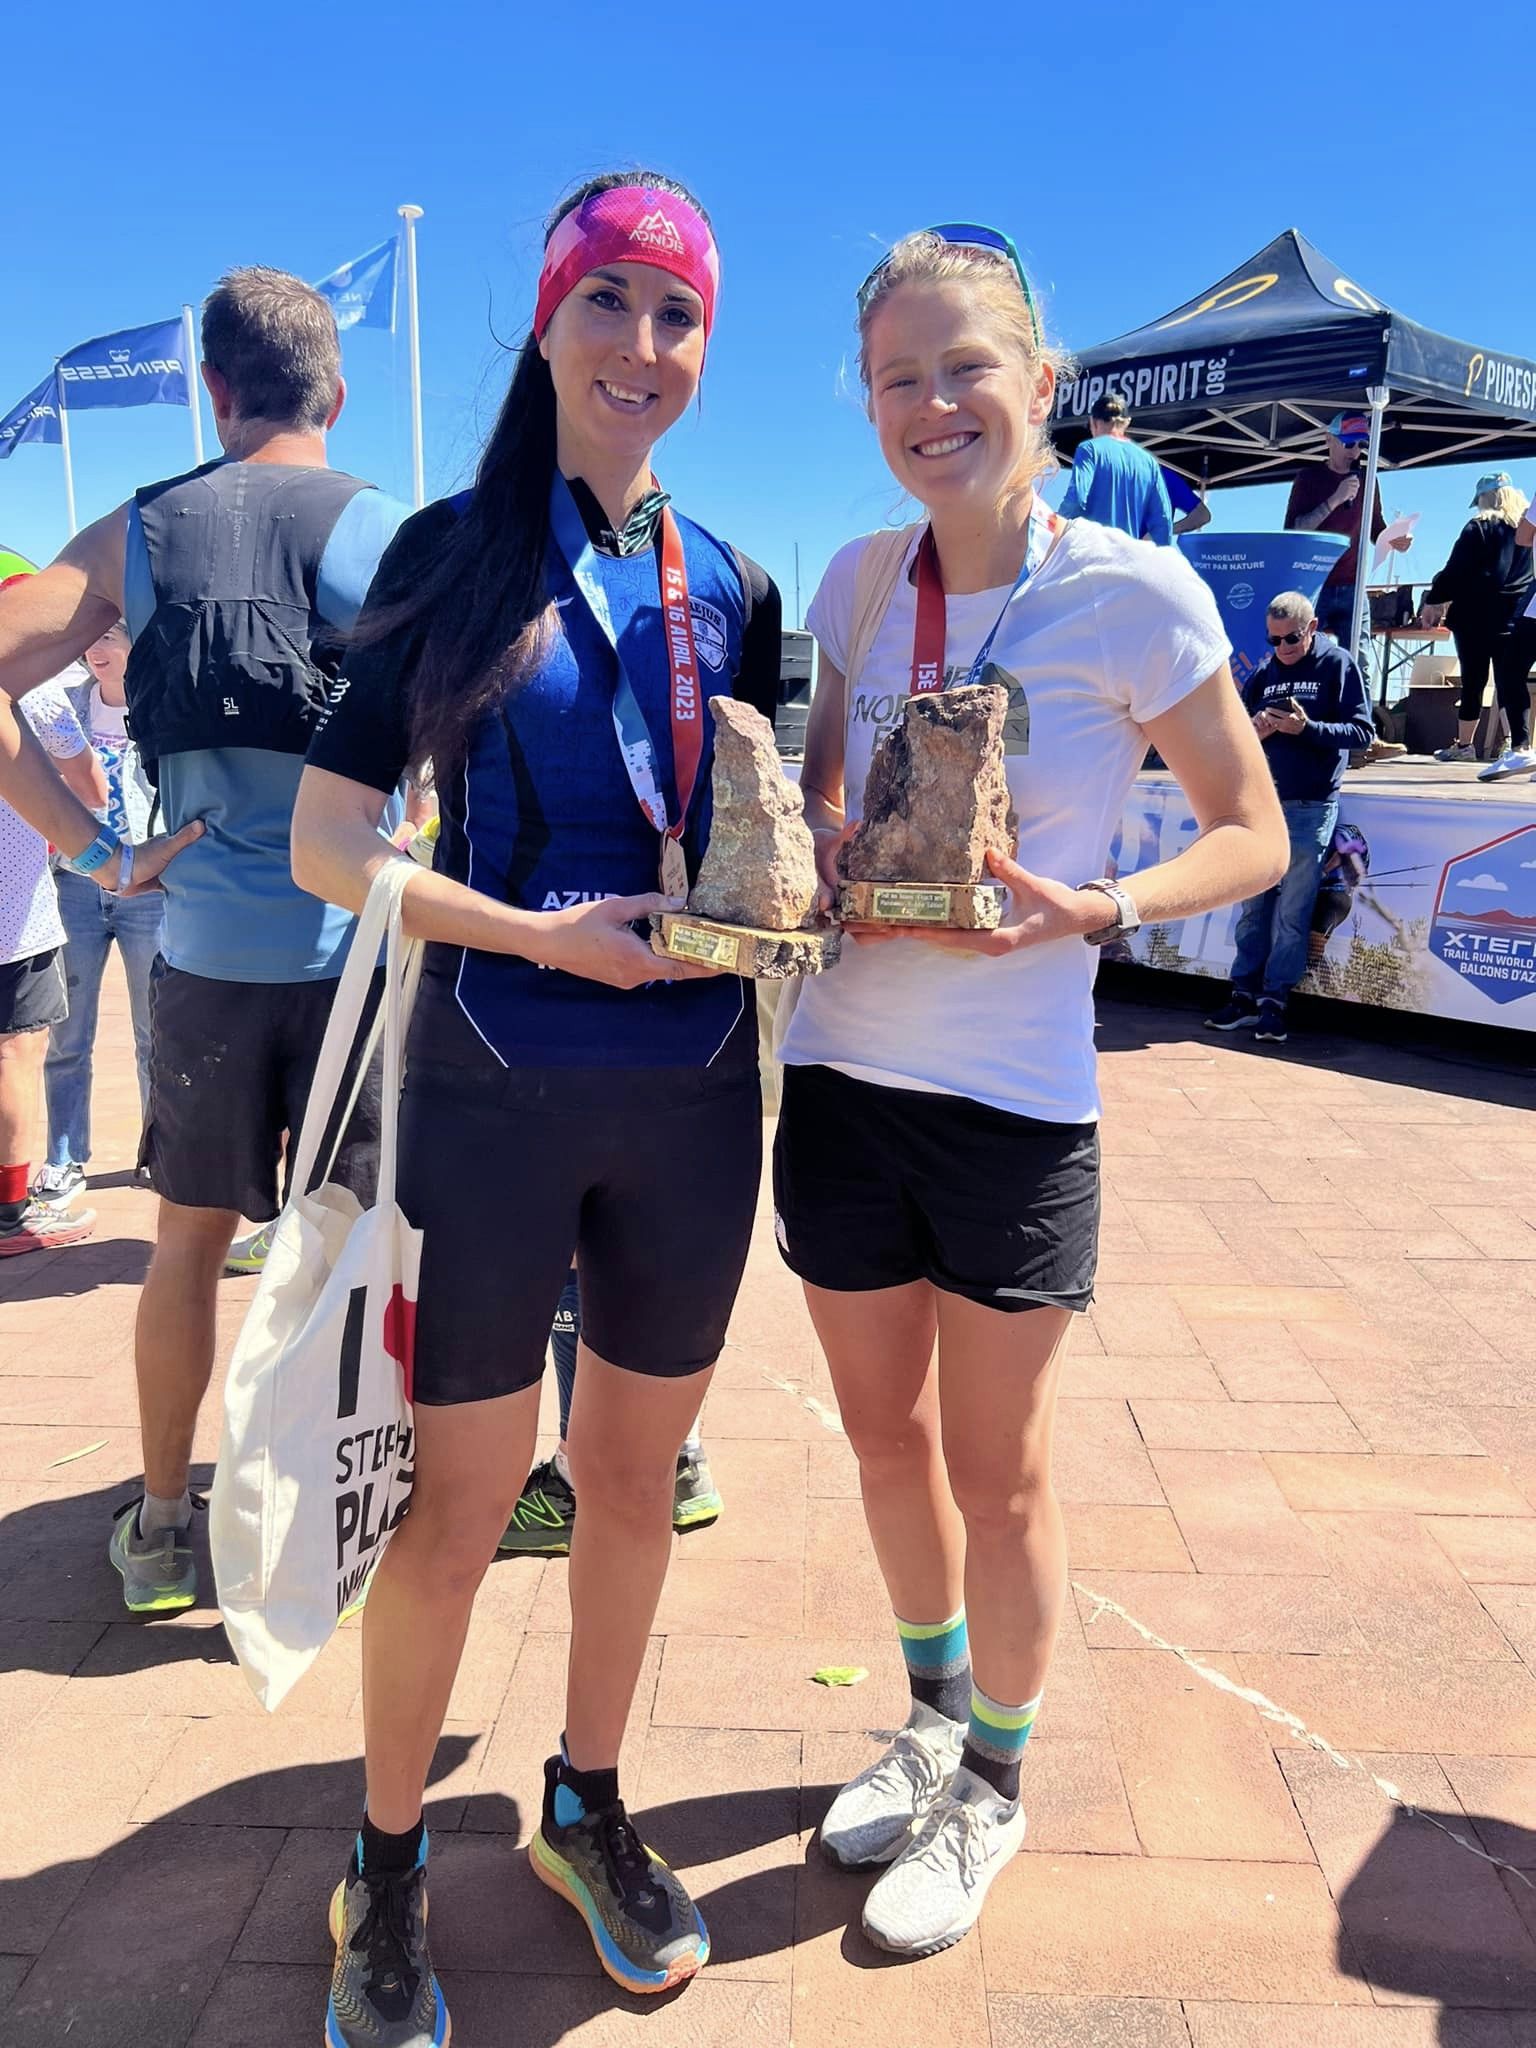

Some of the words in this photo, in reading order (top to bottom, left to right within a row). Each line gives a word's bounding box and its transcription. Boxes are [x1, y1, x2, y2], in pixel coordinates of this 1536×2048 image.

[1057, 360, 1206, 419] PURESPIRIT
[1201, 553, 1247, 562] MANDELIEU
[1229, 560, 1265, 570] NATURE
[666, 567, 682, 586] 15
[667, 588, 683, 601] &
[668, 605, 686, 623] 16
[670, 624, 691, 669] AVRIL
[675, 675, 695, 721] 2023
[1444, 931, 1536, 958] XTER
[1443, 948, 1471, 961] TRAIL
[1472, 952, 1494, 964] RUN
[1496, 955, 1535, 969] WORLD
[1460, 962, 1509, 980] BALCONS
[335, 1420, 415, 1484] STEPH
